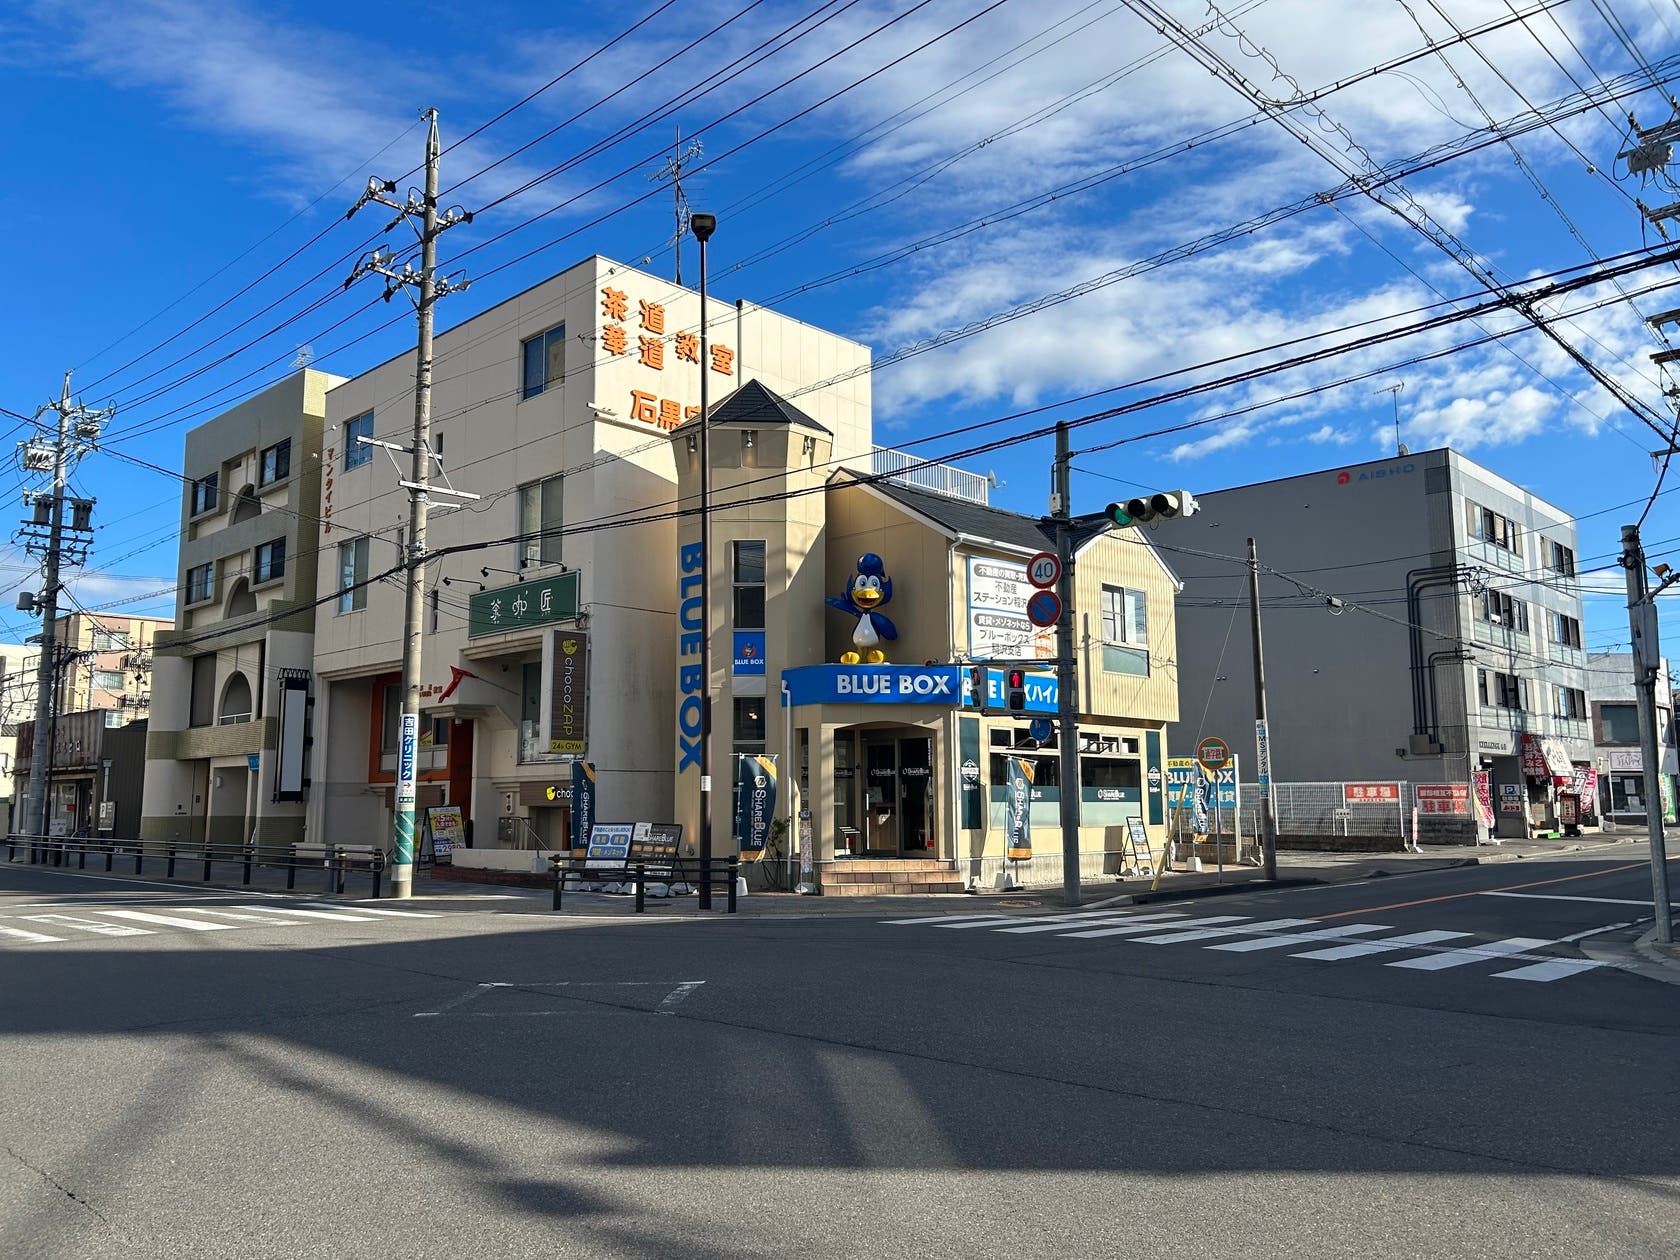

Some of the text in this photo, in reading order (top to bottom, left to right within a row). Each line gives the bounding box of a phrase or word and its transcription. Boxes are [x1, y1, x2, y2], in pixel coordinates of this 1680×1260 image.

[602, 287, 665, 335] 茶道
[630, 389, 700, 430] 石黒
[1358, 464, 1415, 480] AISHO
[324, 447, 334, 534] マンタイビル
[1034, 562, 1053, 578] 40
[995, 580, 1018, 595] 不動産
[979, 629, 1030, 644] ブルーボックス
[679, 541, 703, 774] BLUE BOX
[837, 674, 951, 694] BLUE BOX
[563, 657, 575, 736] chocoZAP
[402, 718, 414, 779] 吉田クリニック
[565, 742, 582, 751] GYM
[1167, 771, 1194, 784] BLU
[1506, 786, 1514, 794] P
